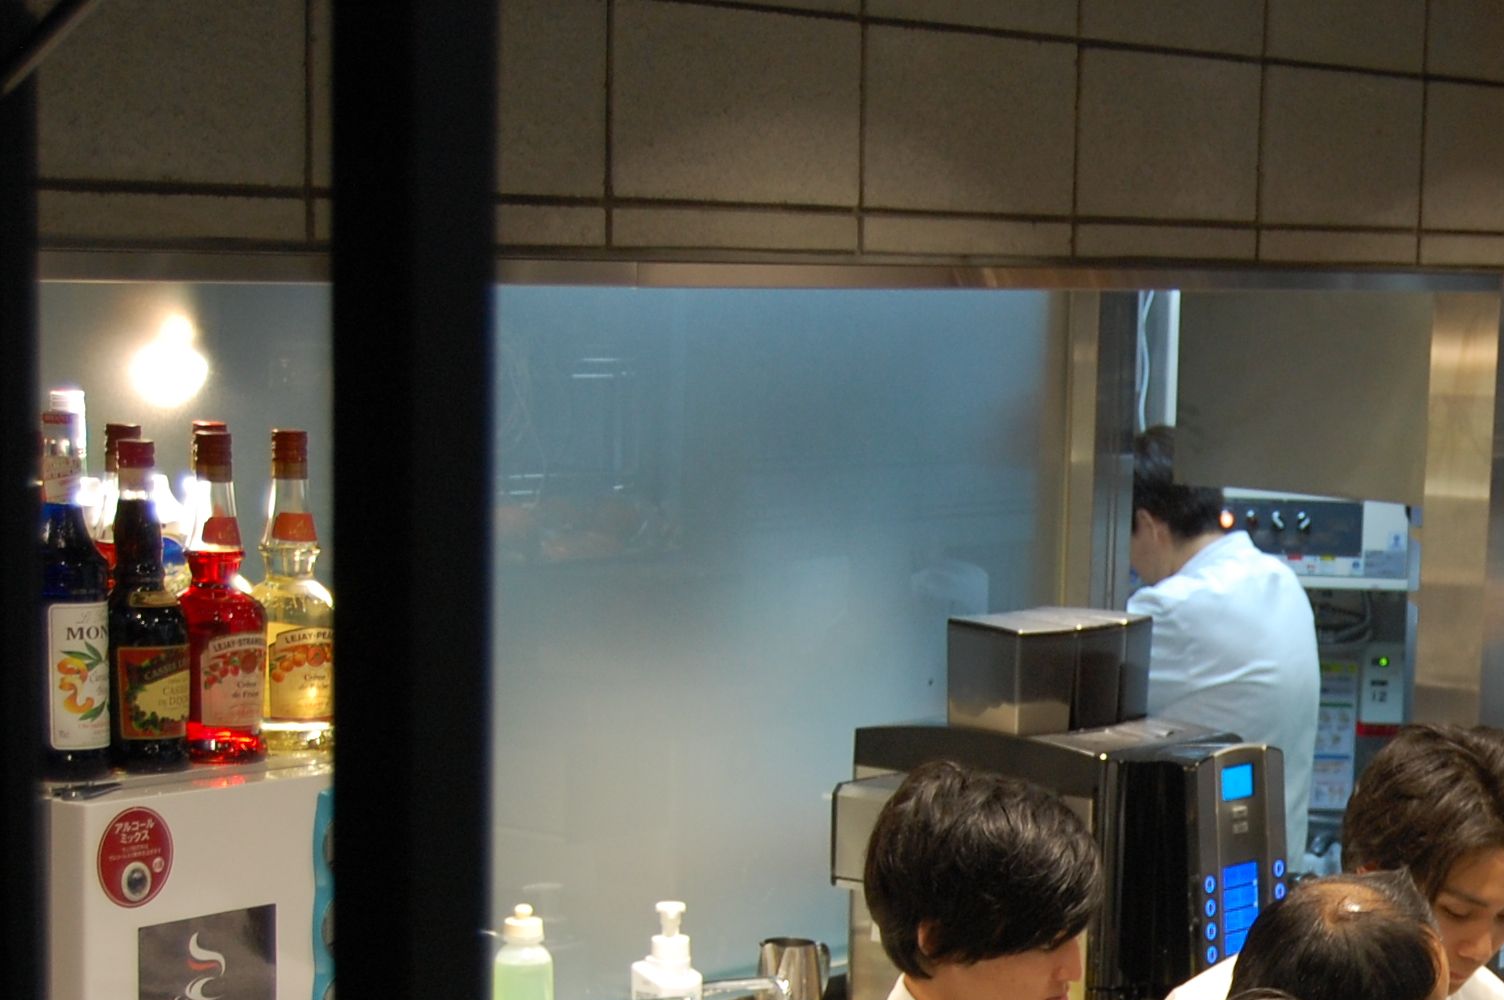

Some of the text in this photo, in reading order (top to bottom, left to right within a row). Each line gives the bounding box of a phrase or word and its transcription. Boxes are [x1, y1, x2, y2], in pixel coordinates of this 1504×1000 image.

[66, 625, 109, 641] MON
[114, 818, 155, 834] アルコール
[119, 830, 150, 844] ミックス
